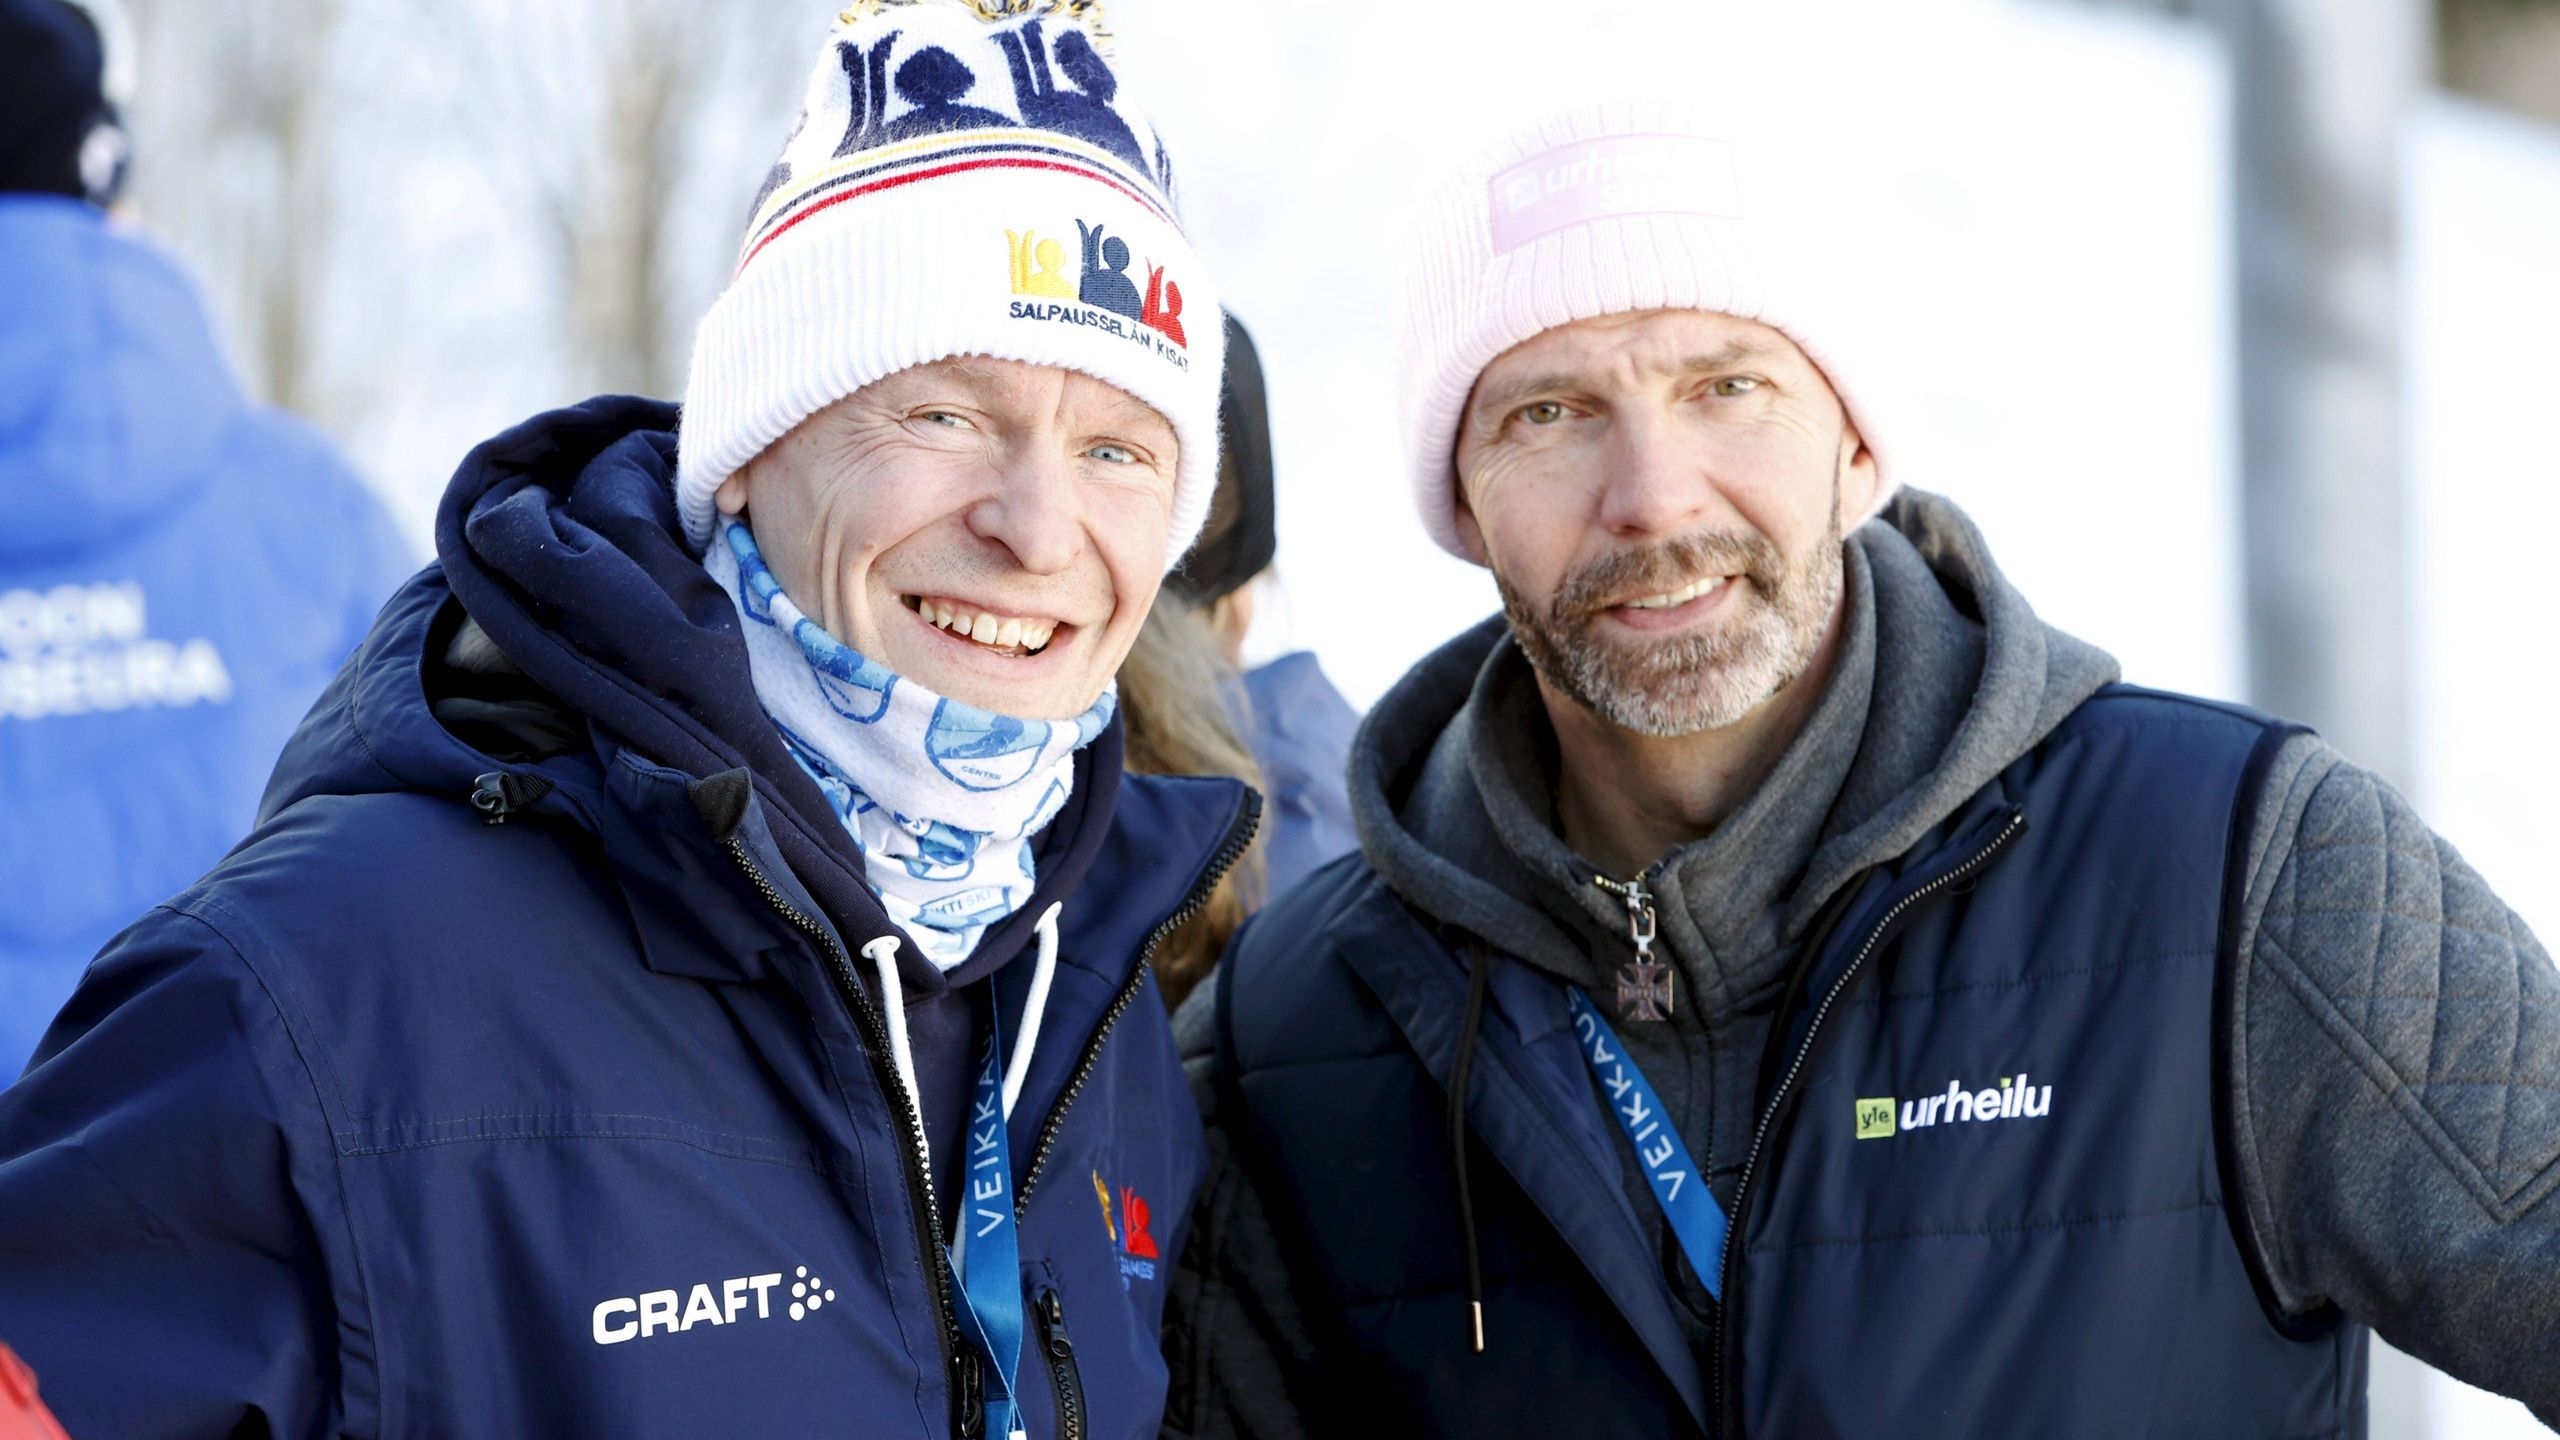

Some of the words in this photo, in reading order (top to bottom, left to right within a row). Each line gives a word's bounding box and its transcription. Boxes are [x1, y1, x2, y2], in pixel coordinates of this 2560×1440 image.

[1009, 301, 1151, 350] SALPAUSSELÄN
[961, 765, 1002, 781] CENTER
[1900, 1073, 2053, 1131] urheilu
[974, 1025, 1005, 1238] VEIKKAU
[592, 1272, 782, 1345] CRAFT
